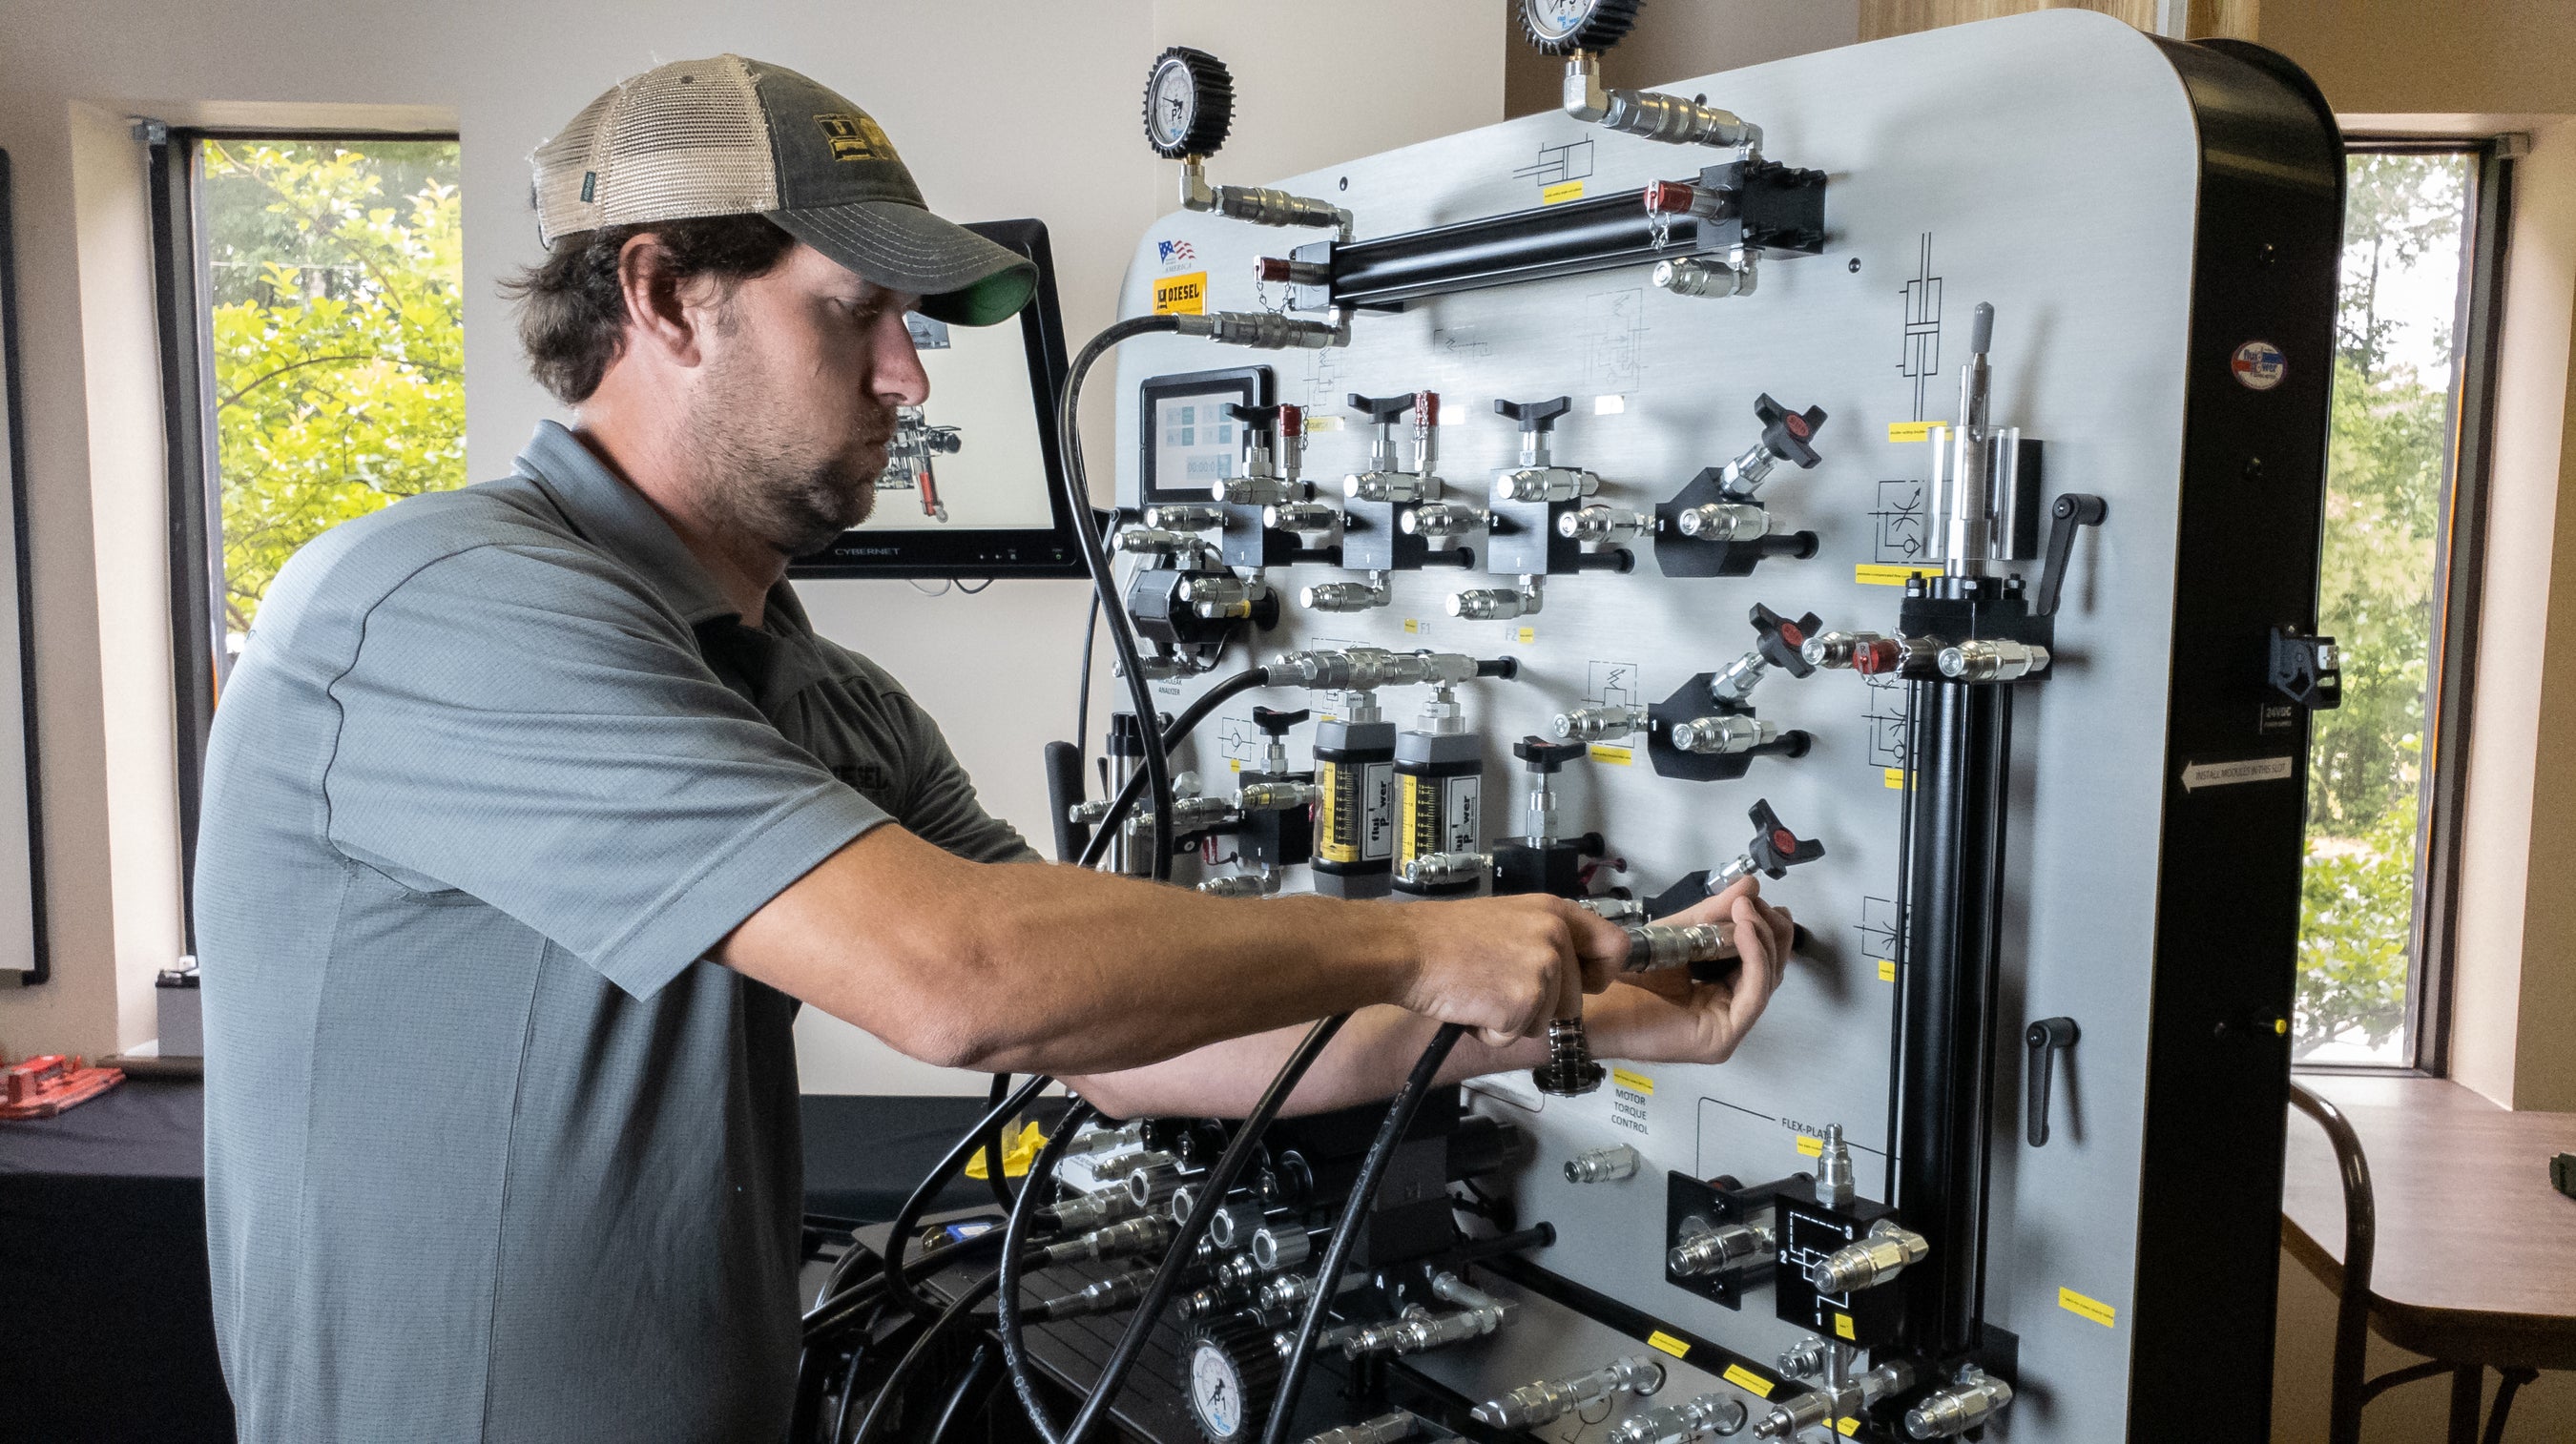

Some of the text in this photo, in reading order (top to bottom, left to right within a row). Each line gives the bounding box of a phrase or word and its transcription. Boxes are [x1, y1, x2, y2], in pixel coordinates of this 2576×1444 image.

[1172, 107, 1183, 121] P2
[1168, 283, 1199, 302] DIESEL
[1224, 516, 1229, 526] 2
[1346, 516, 1352, 526] 2
[1492, 515, 1499, 527] 2
[1658, 519, 1665, 532] 1
[835, 547, 901, 556] CYBERNET
[1240, 550, 1245, 561] 1
[1366, 553, 1370, 564] 1
[1516, 556, 1521, 567] 1
[1420, 622, 1431, 635] F1
[1505, 629, 1517, 641] F2
[1158, 687, 1181, 696] ANALYZER
[2266, 707, 2292, 718] 24VDC
[1651, 719, 1657, 731] 1
[2195, 763, 2286, 781] INSTALL MODULES IN THIS SLOT
[1241, 810, 1246, 819] 2
[1257, 847, 1261, 856] 1
[1496, 866, 1503, 877] 2
[1615, 1088, 1646, 1106] MOTOR
[1613, 1102, 1647, 1121] TORQUE
[1611, 1115, 1649, 1135] CONTROL
[1781, 1117, 1829, 1141] FLEX-PLAT
[1844, 1225, 1853, 1240] 3
[1779, 1249, 1787, 1265] 2
[1424, 1265, 1431, 1278] T
[1376, 1274, 1383, 1289] A
[1398, 1284, 1405, 1297] P
[1816, 1312, 1821, 1327] 1
[1214, 1392, 1226, 1412] P1
